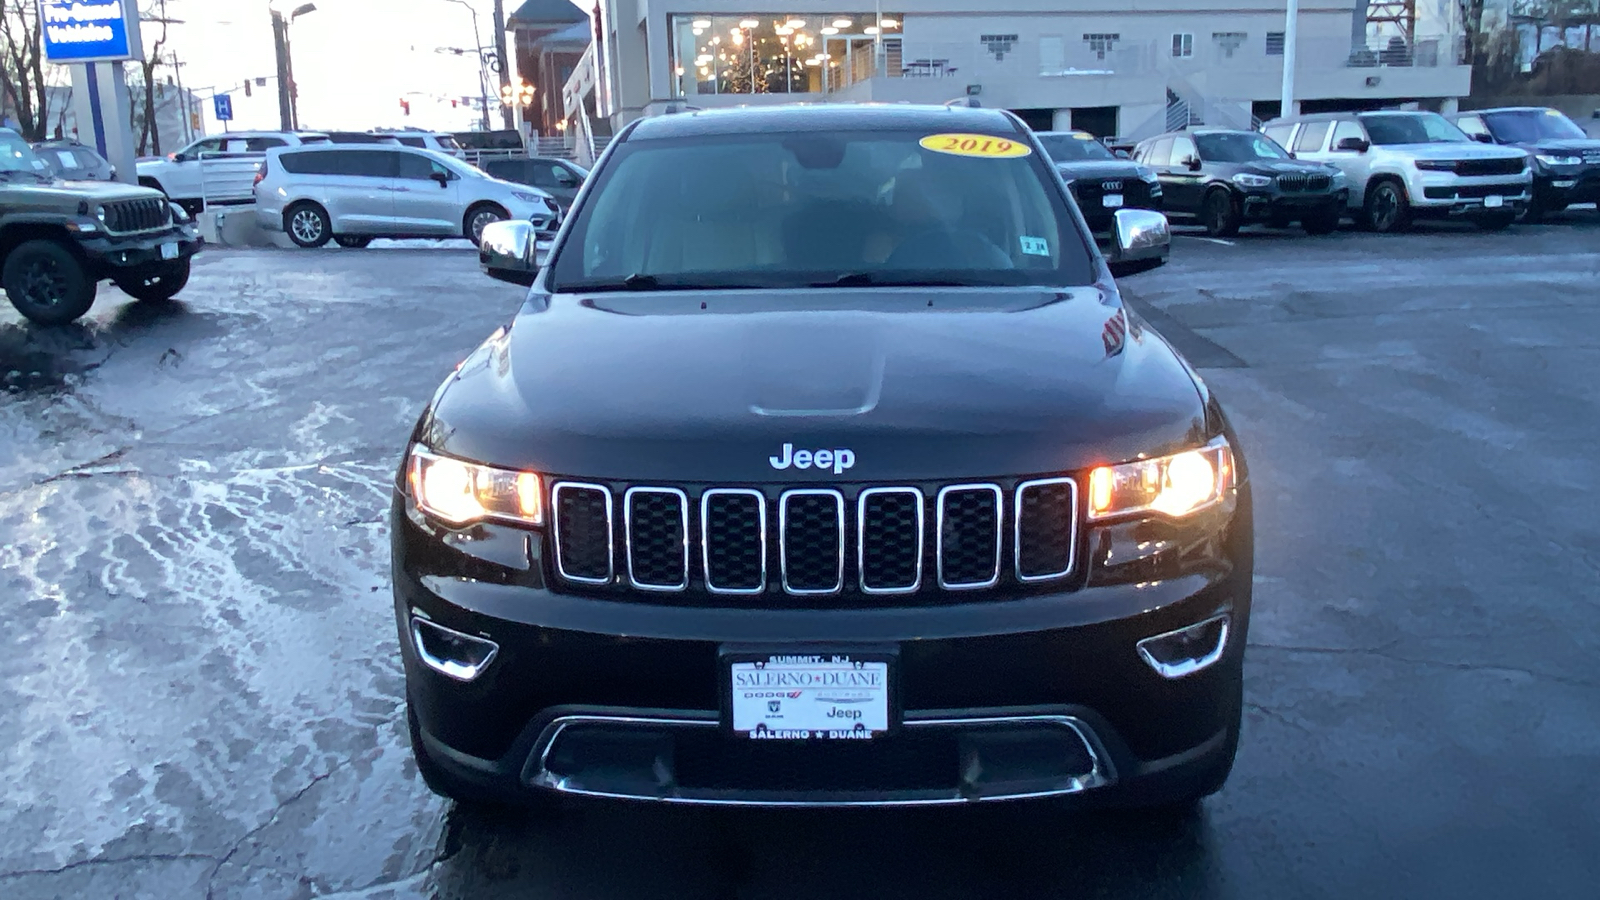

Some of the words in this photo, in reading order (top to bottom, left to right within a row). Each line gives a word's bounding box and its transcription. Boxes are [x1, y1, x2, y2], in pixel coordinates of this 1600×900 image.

[218, 100, 228, 114] H
[942, 138, 1012, 153] 2019
[769, 443, 855, 475] Jeep
[831, 655, 850, 663] NJ
[736, 672, 812, 686] SALERNO
[823, 672, 881, 686] DUANE
[826, 706, 862, 720] Jeep
[750, 730, 809, 739] SALERNO
[829, 730, 872, 739] DUANE
